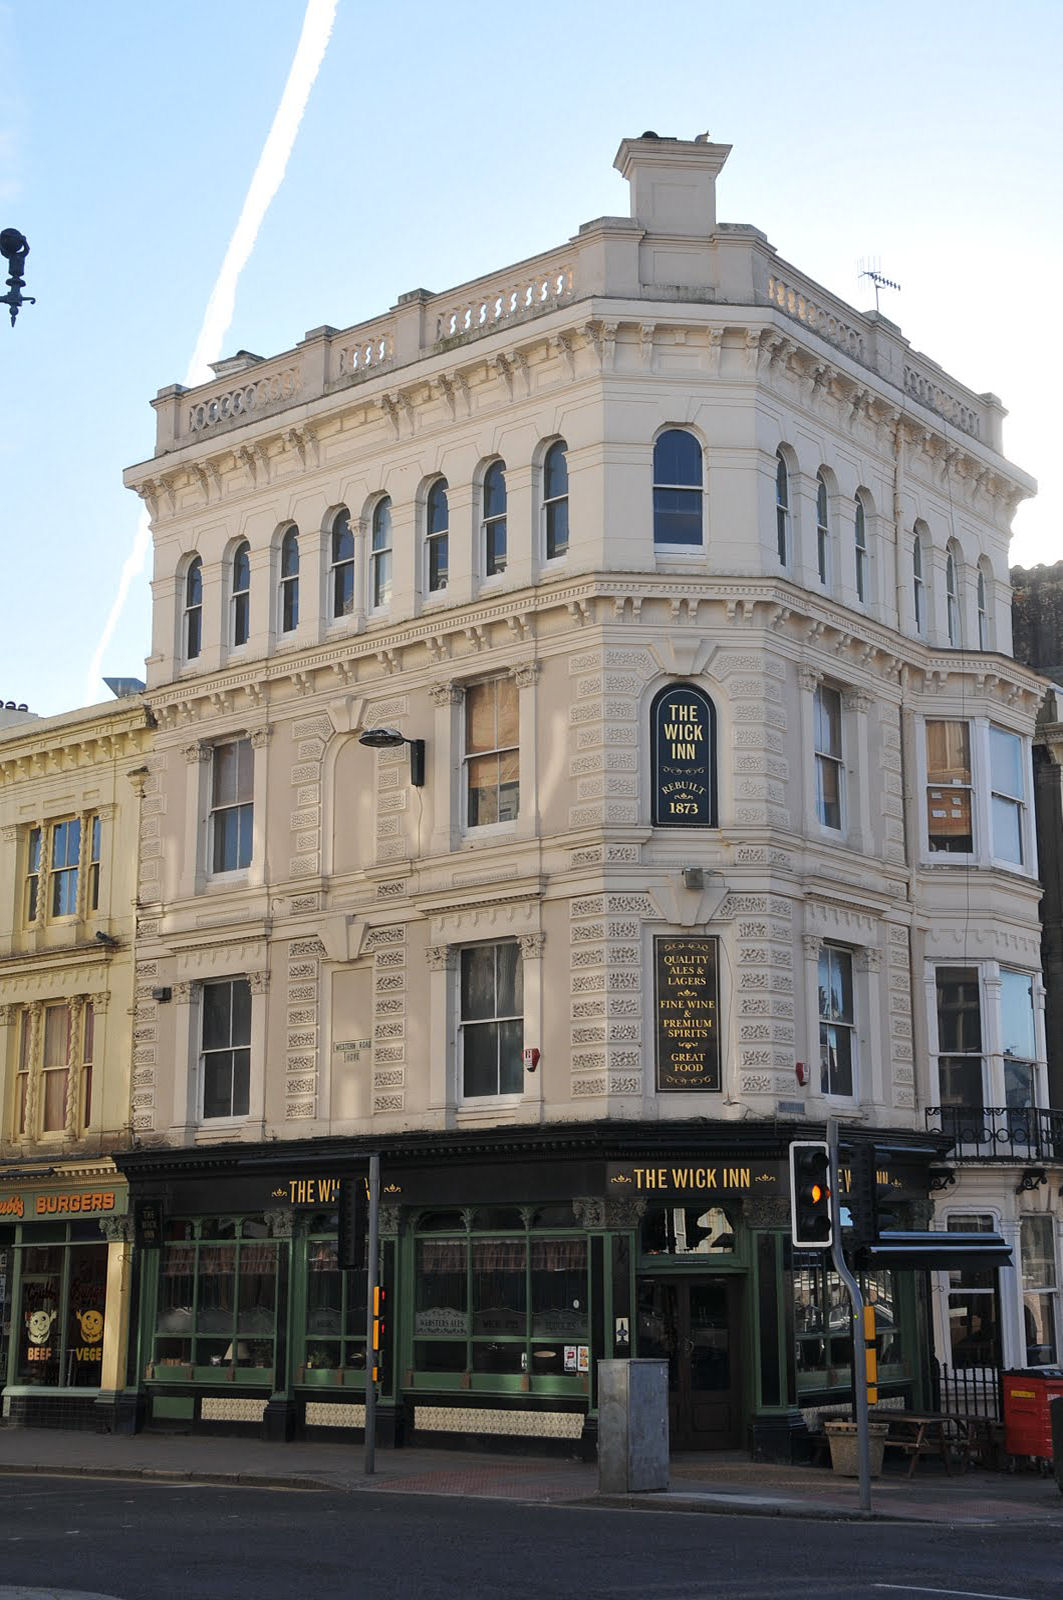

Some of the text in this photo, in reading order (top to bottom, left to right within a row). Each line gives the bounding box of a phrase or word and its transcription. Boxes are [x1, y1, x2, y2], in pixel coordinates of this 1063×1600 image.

[668, 704, 698, 722] THE
[664, 724, 703, 740] WICK
[672, 744, 696, 760] INN
[662, 781, 706, 796] REBUILT
[668, 803, 699, 814] 1873
[664, 955, 708, 966] QUALITY
[670, 966, 704, 975] ALES &
[660, 1000, 715, 1009] FINE WINE
[683, 1009, 692, 1018] &
[664, 1019, 712, 1028] PREMIUM
[668, 1029, 708, 1038] SPIRITS
[671, 1053, 706, 1061] GREAT
[674, 1064, 704, 1072] FOOD
[634, 1168, 750, 1188] THE WICK INN
[290, 1180, 315, 1204] THE
[318, 1178, 342, 1202] WI
[36, 1192, 115, 1214] BURGERS
[27, 1347, 52, 1360] BEEF
